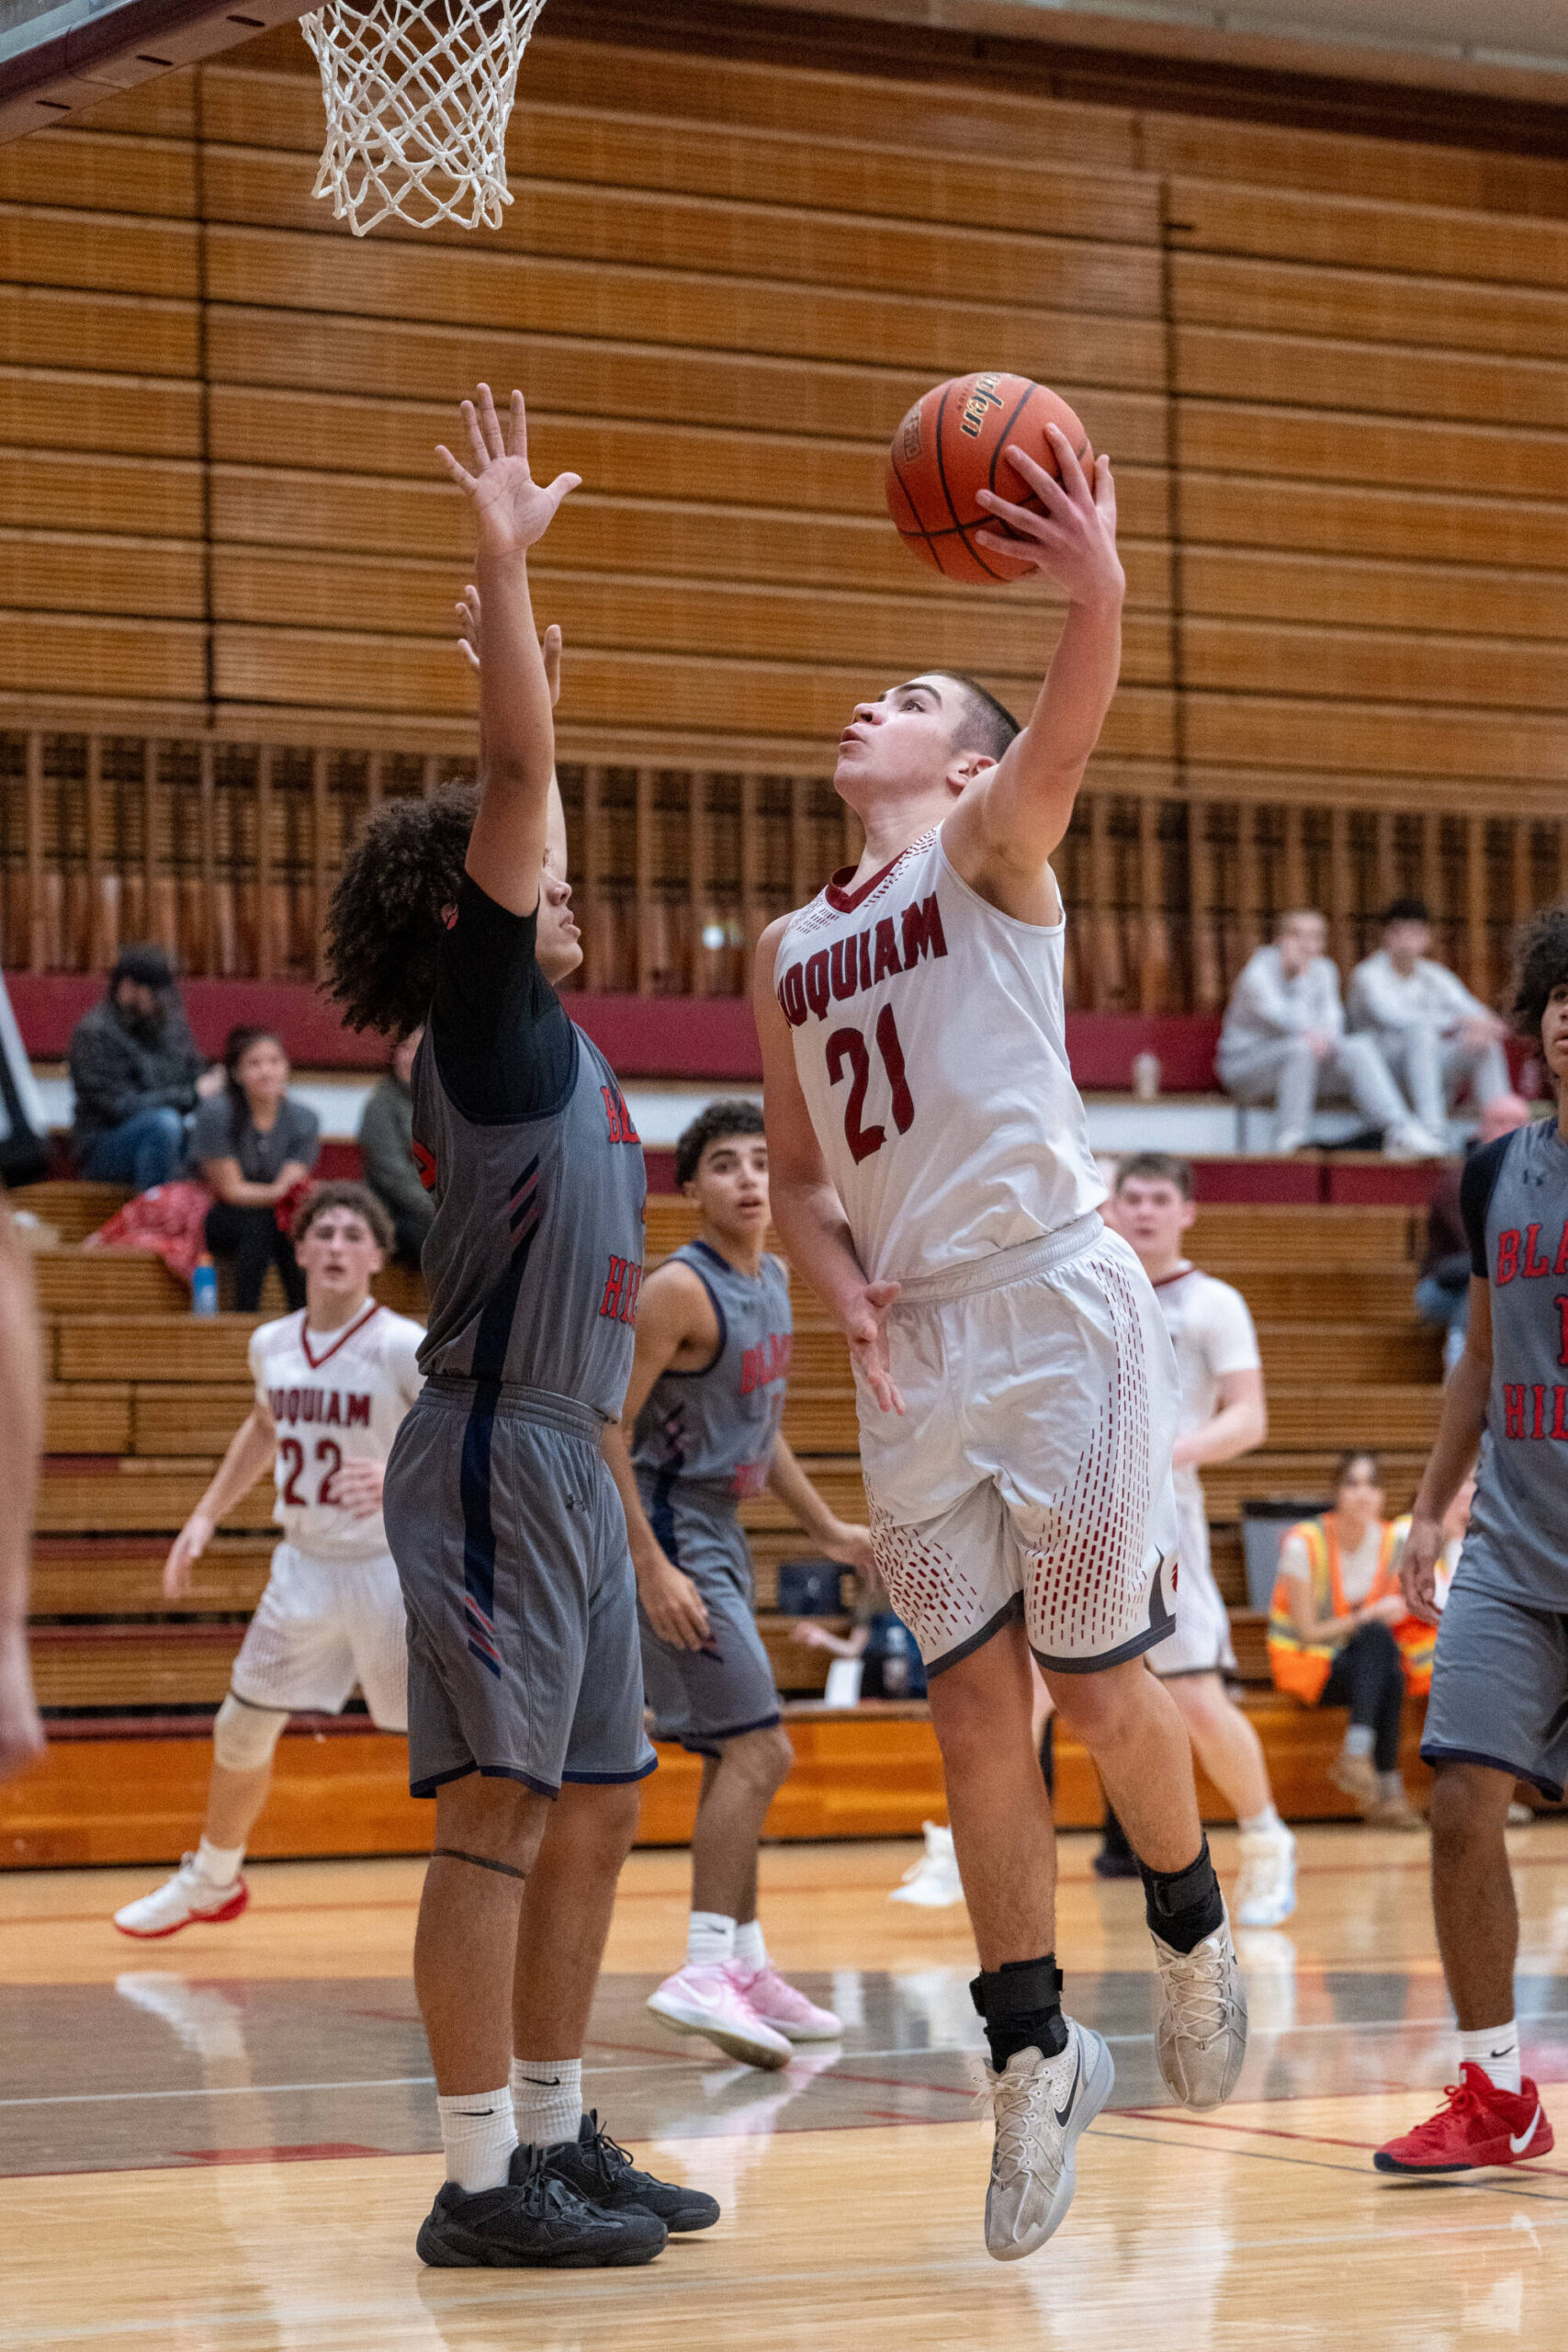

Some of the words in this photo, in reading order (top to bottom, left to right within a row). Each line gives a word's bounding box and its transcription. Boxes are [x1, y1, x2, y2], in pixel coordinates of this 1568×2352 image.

[778, 891, 948, 1027] OQUIAM
[826, 1002, 915, 1166] 21
[279, 1438, 343, 1506] 22
